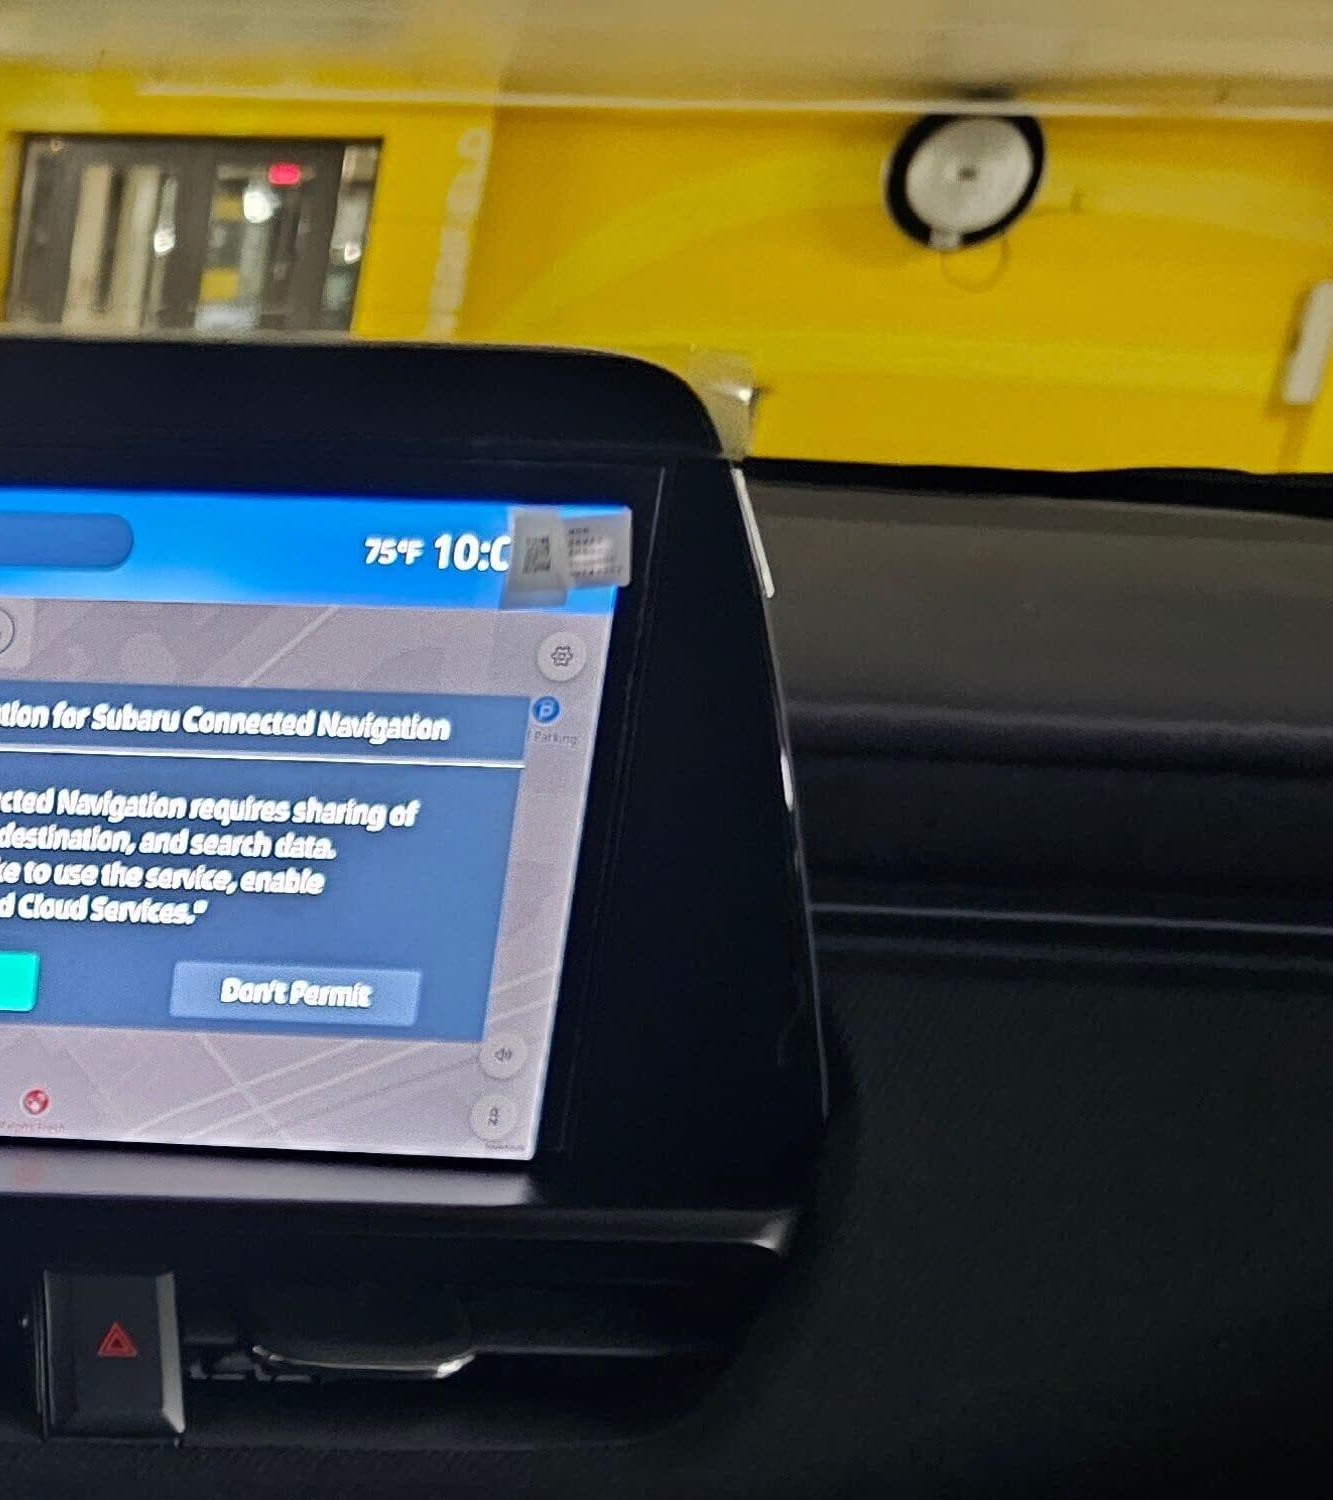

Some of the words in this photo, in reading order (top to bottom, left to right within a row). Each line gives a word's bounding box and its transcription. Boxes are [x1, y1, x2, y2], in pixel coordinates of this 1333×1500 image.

[52, 701, 91, 730] for
[91, 703, 181, 733] Subaru
[183, 705, 316, 737] Connected
[317, 709, 450, 745] Navigation
[57, 788, 187, 823] Navigation
[189, 795, 291, 826] requires
[291, 796, 387, 832] sharing
[389, 800, 421, 827] of
[139, 828, 189, 854] and
[190, 830, 272, 858] search
[274, 832, 336, 859] data.
[23, 860, 52, 885] to
[54, 863, 99, 886] use
[101, 861, 144, 888] the
[145, 865, 238, 895] service,
[240, 867, 326, 895] enable
[17, 893, 90, 921] Cloud
[90, 895, 209, 925] Services."
[220, 976, 288, 1006] Don't
[289, 979, 372, 1010] Permit
